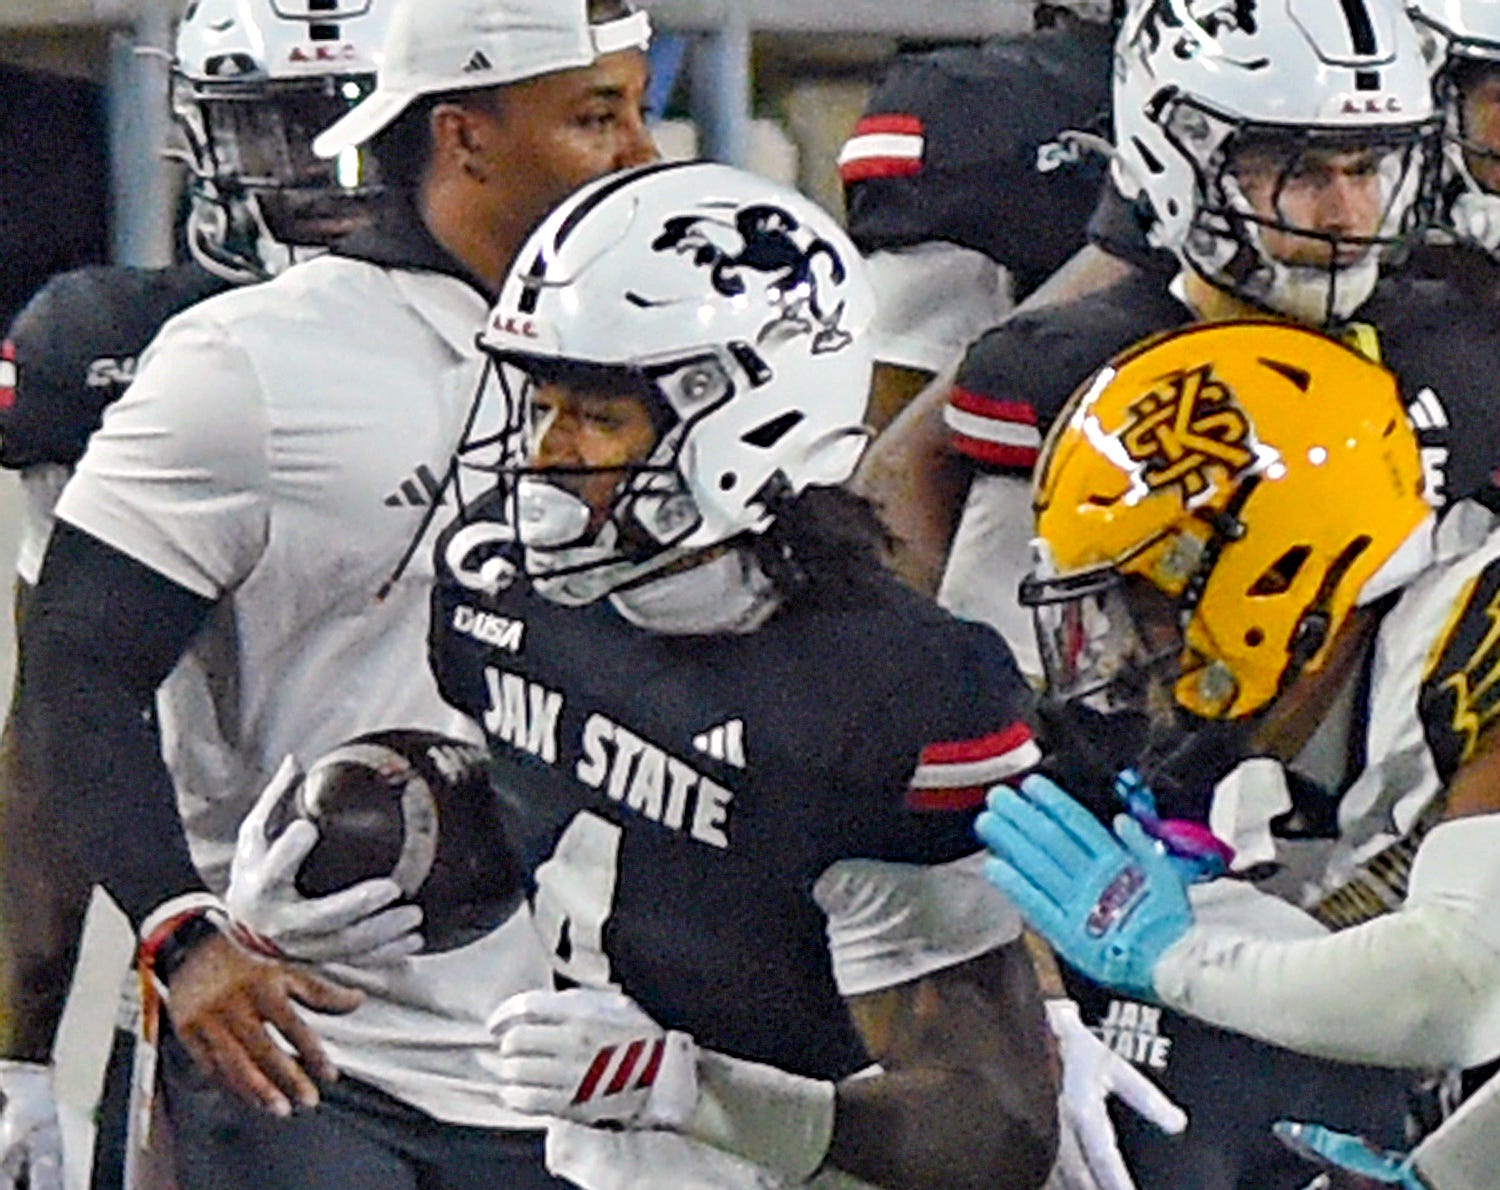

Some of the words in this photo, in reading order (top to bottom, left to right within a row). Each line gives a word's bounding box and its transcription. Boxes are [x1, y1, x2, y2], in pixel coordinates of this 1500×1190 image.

[483, 665, 564, 764] JAX
[576, 712, 735, 849] STATE
[535, 809, 623, 993] 4
[1101, 1000, 1162, 1036] JAX
